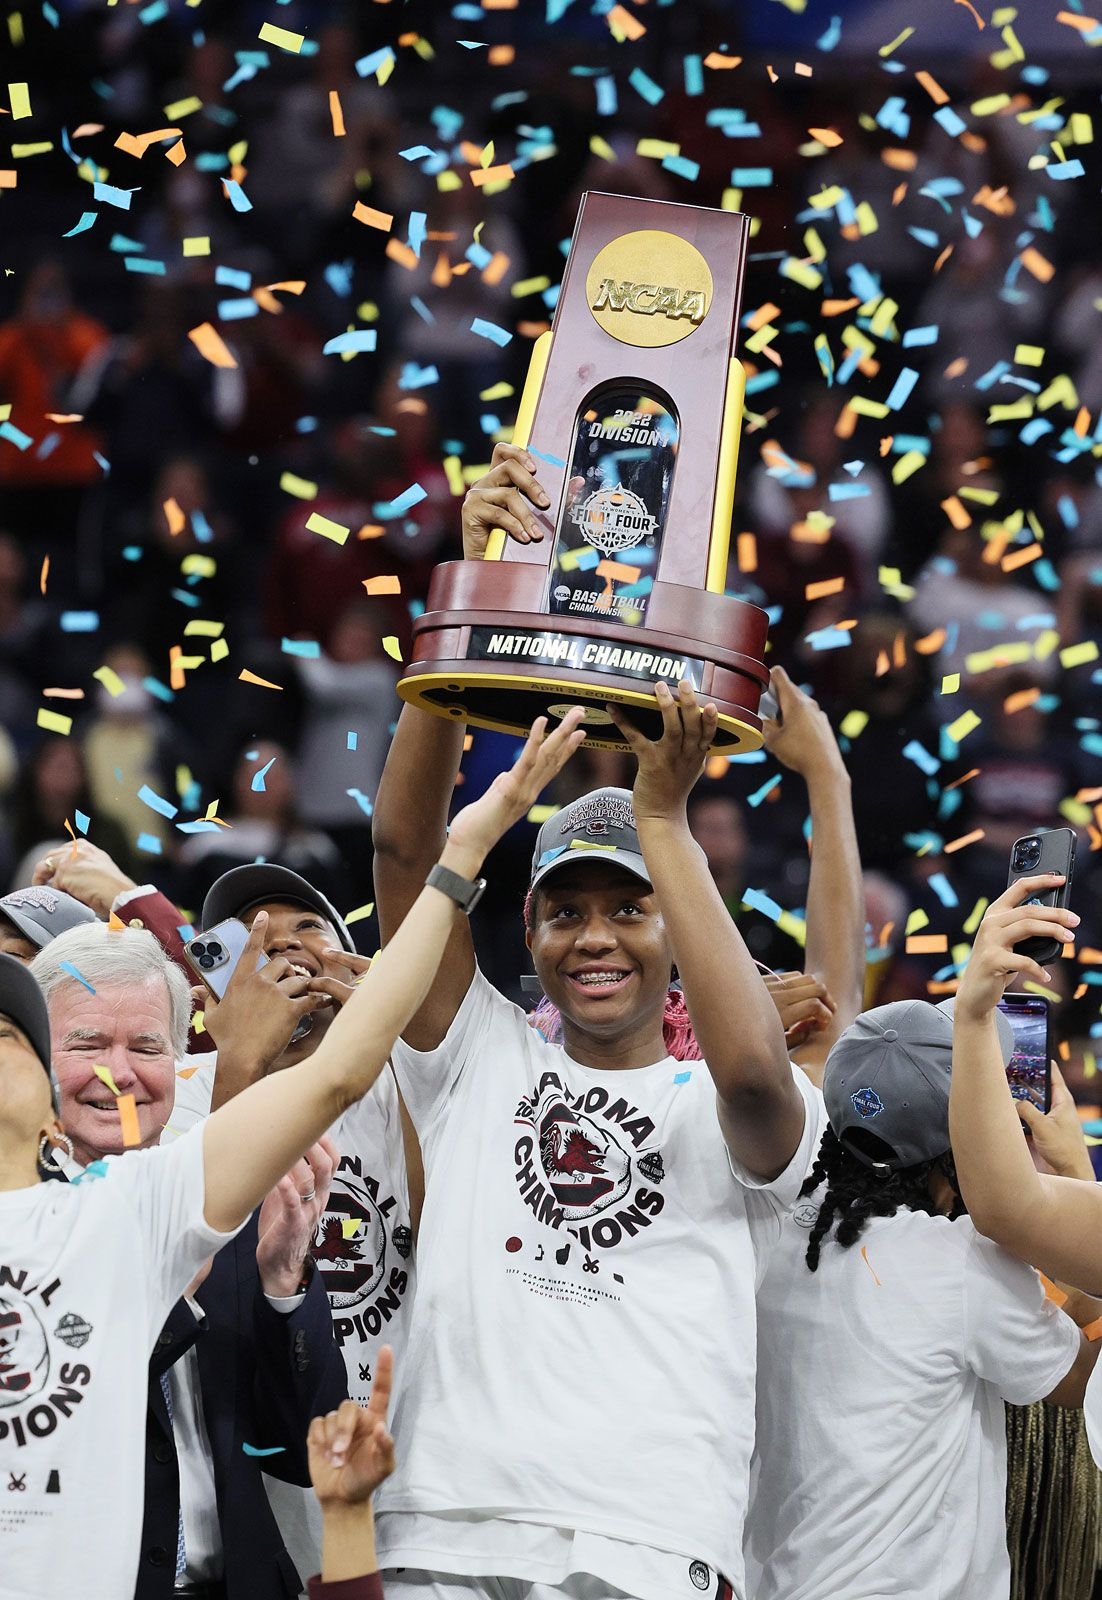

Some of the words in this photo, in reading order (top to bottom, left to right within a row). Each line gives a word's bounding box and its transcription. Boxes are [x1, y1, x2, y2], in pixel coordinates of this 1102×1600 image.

[592, 278, 706, 326] NCAA
[614, 408, 652, 427] 2022
[588, 422, 660, 447] DIVISION
[615, 514, 651, 532] FOUR
[572, 589, 646, 611] BASTBALL
[487, 634, 578, 661] NATIONAL
[582, 644, 687, 680] CHAMPION
[530, 683, 563, 693] April
[585, 690, 624, 702] 2022
